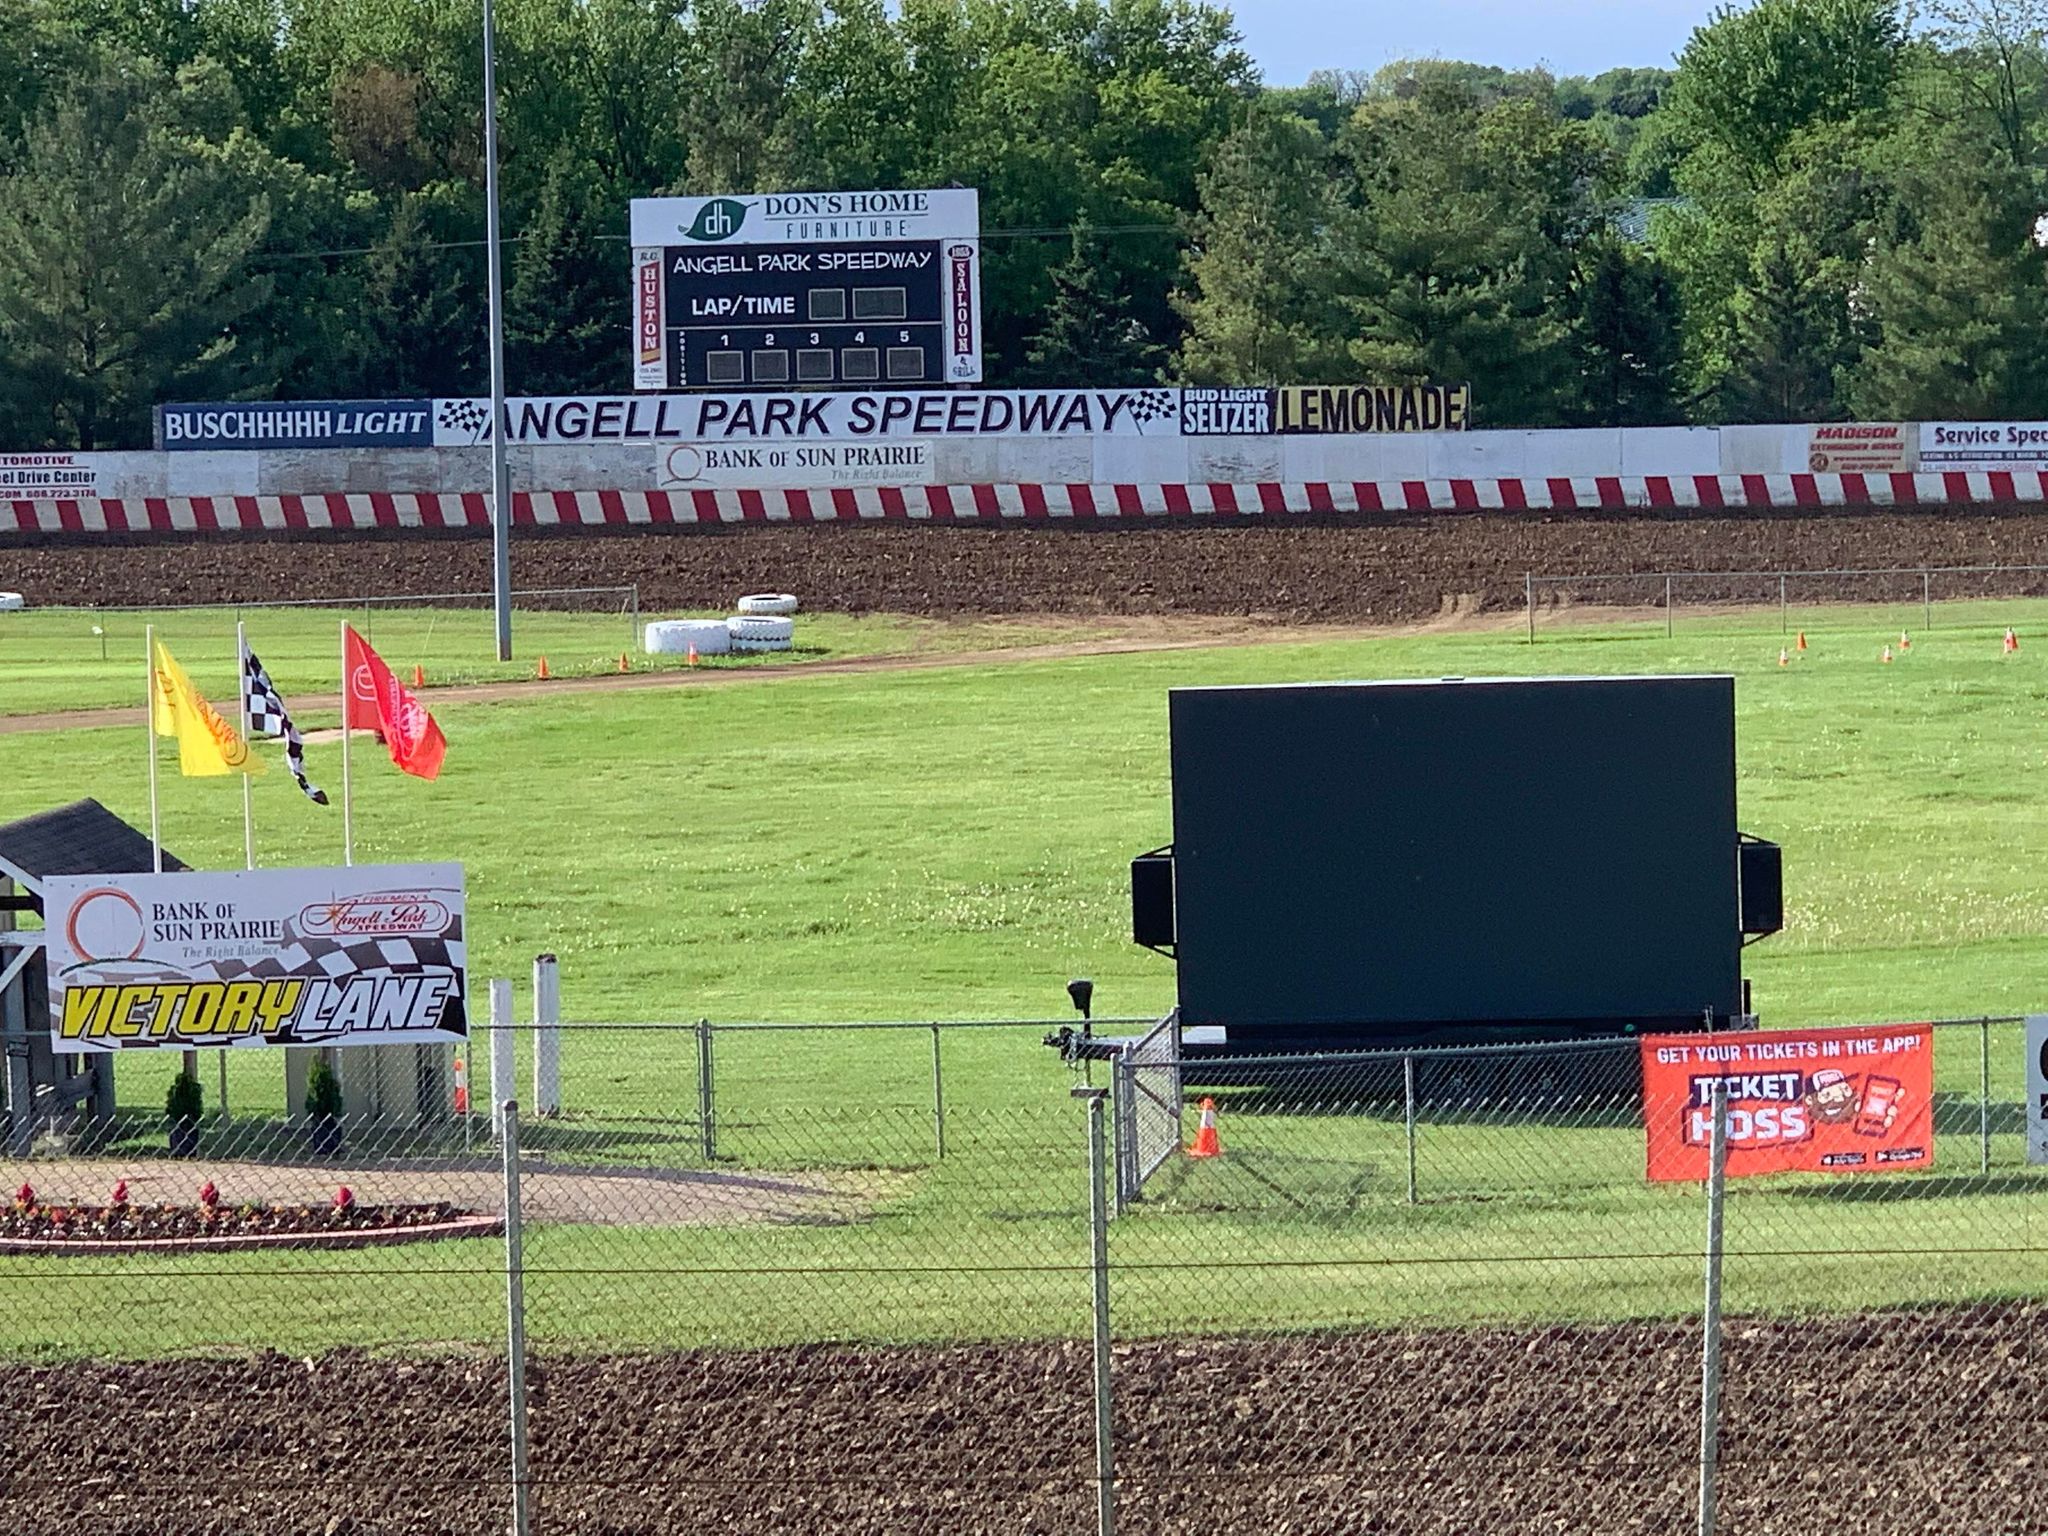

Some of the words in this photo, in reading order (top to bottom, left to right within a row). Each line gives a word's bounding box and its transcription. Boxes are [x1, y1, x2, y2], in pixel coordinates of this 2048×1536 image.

[765, 195, 842, 215] DON'S
[850, 192, 929, 213] HOME
[705, 202, 732, 235] dh
[786, 220, 907, 239] FURNITURE
[673, 256, 753, 275] ANGELL
[757, 254, 811, 272] PARK
[818, 252, 932, 270] SPEEDWAY
[643, 267, 658, 349] HUSTON
[692, 295, 795, 316] LAP/TIME
[956, 262, 969, 352] SALOON
[720, 334, 729, 346] 1
[765, 333, 775, 345] 2
[810, 332, 820, 344] 3
[854, 331, 865, 344] 4
[900, 330, 910, 342] 5
[1184, 390, 1217, 402] BUD
[1219, 389, 1267, 402] LIGHT
[696, 398, 835, 437] PARK
[846, 394, 1128, 434] SPEEDWAY
[1183, 403, 1269, 434] SELTZER
[1277, 386, 1469, 432] LEMONADE
[165, 410, 332, 440] BUSCHHHHH
[335, 411, 427, 434] LIGHT
[1816, 427, 1898, 439] MADISON
[1935, 426, 2000, 444] Service
[2007, 426, 2048, 447] Spec
[0, 456, 75, 465] TOMOTIVE
[706, 450, 763, 468] BANK
[796, 448, 836, 467] SUN
[843, 446, 925, 465] PRAIRIE
[18, 471, 50, 483] Drive
[54, 470, 96, 483] Center
[152, 902, 209, 921] BANK
[216, 903, 237, 919] OF
[385, 904, 428, 923] Park
[153, 923, 193, 942] SUN
[200, 920, 281, 940] PRAIRIE
[357, 923, 424, 931] SPEEDWAY
[182, 947, 202, 958] The
[205, 946, 234, 960] Right
[60, 981, 306, 1039] VICTORY
[296, 975, 454, 1033] LANE
[1657, 1047, 1690, 1064] GET
[1695, 1045, 1741, 1062] YOUR
[1748, 1042, 1818, 1059] TICKETS
[1822, 1040, 1841, 1056] IN
[1844, 1039, 1878, 1055] THE
[1881, 1035, 1921, 1052] APP!
